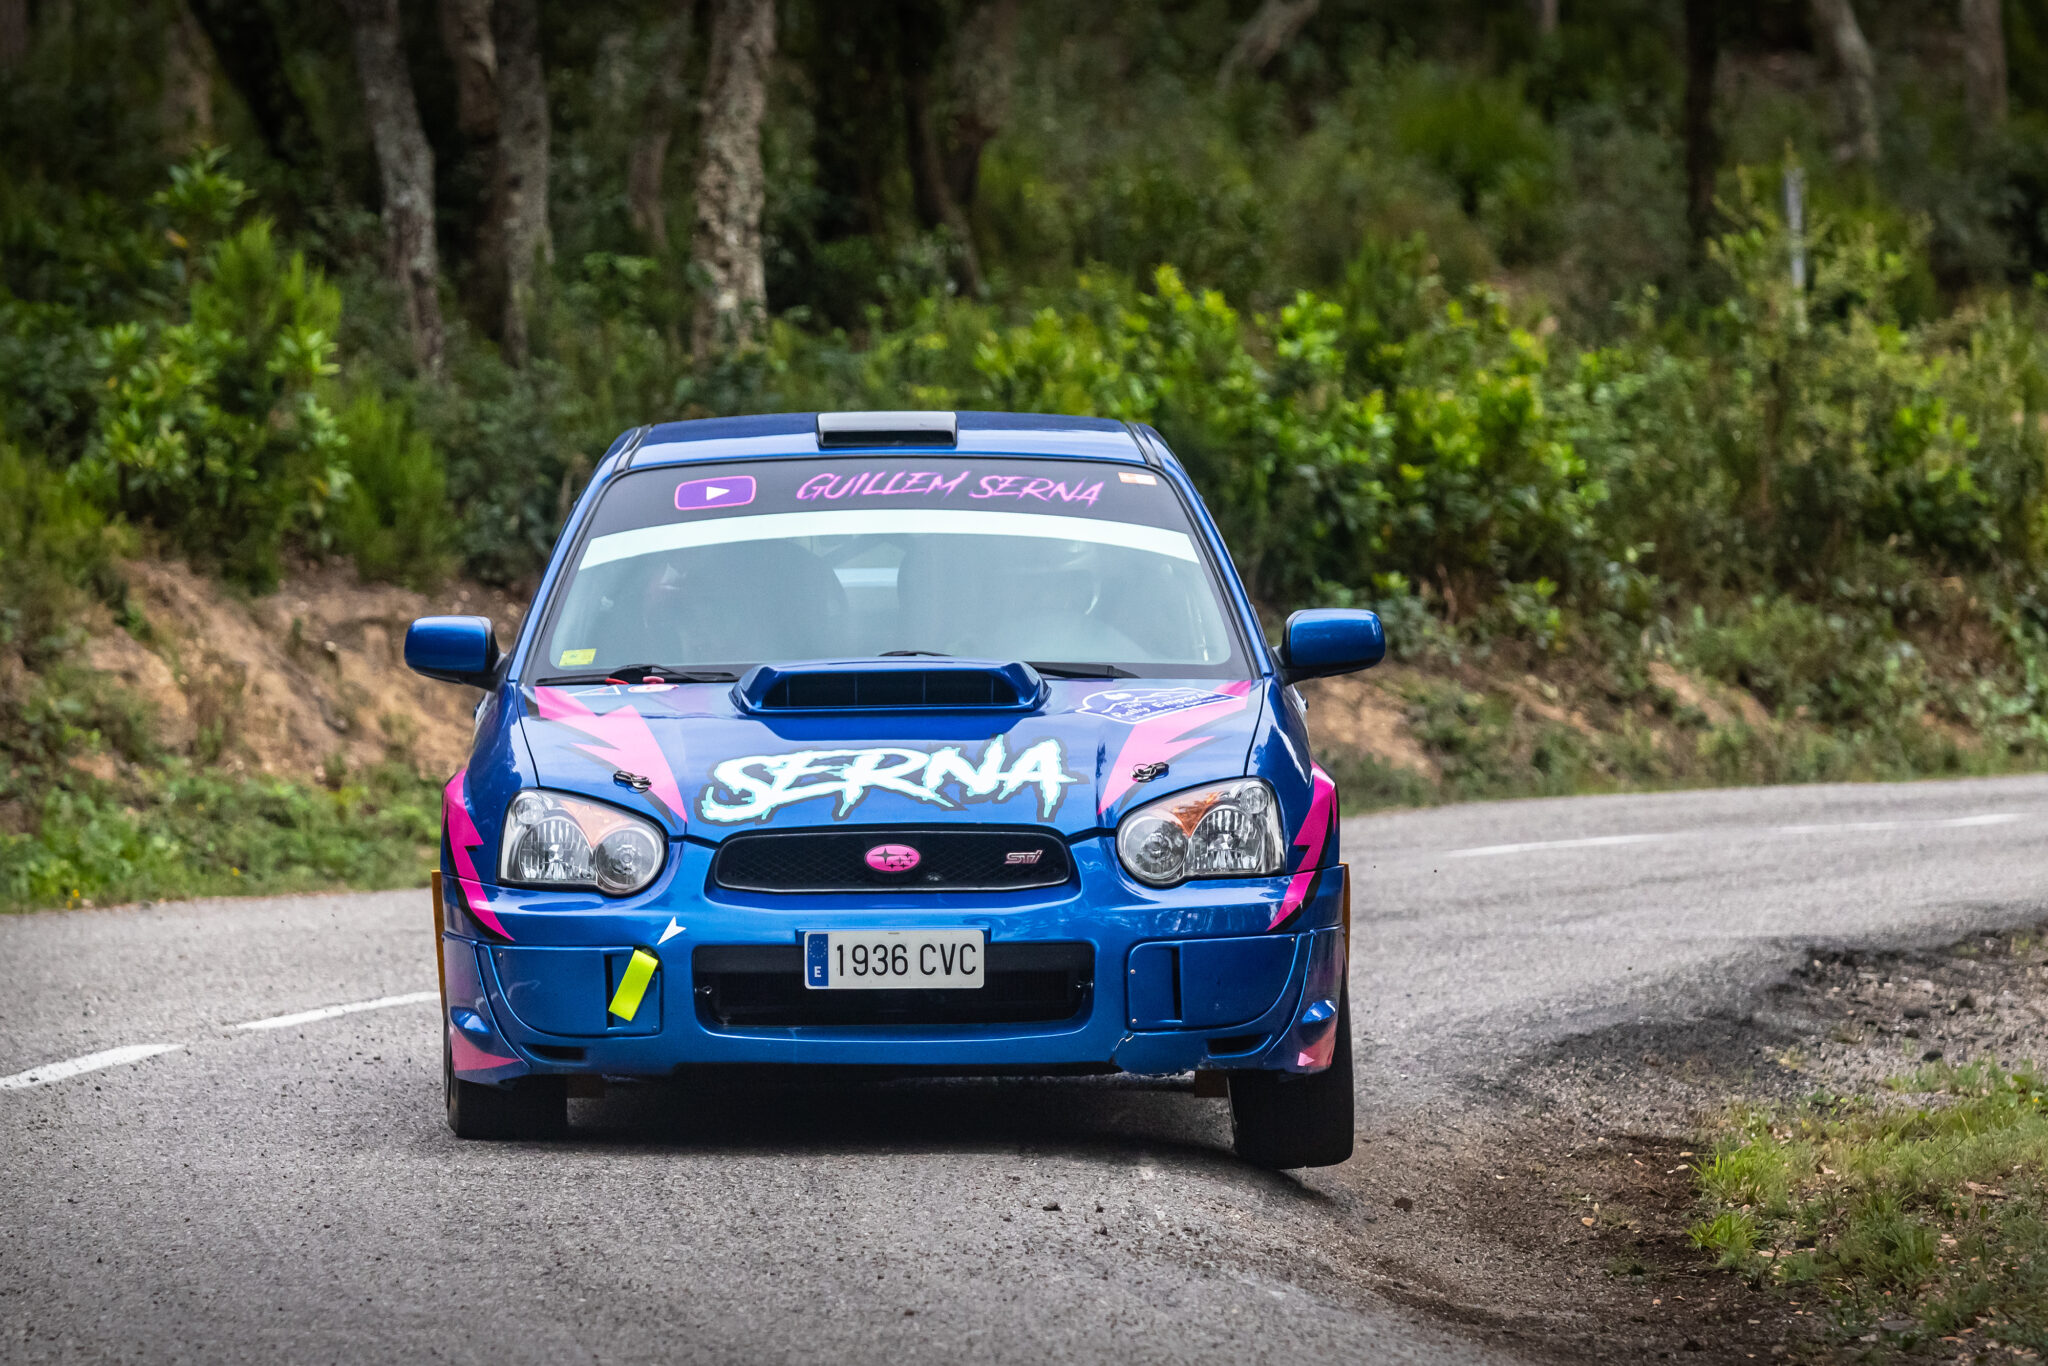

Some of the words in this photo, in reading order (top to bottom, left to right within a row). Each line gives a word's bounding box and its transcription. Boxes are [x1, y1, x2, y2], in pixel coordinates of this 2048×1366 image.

[796, 470, 971, 500] GUILLEM
[968, 475, 1105, 507] SERNA
[699, 733, 1080, 822] SERNA
[813, 966, 822, 978] E
[836, 944, 909, 976] 1936
[919, 943, 977, 976] CVC
